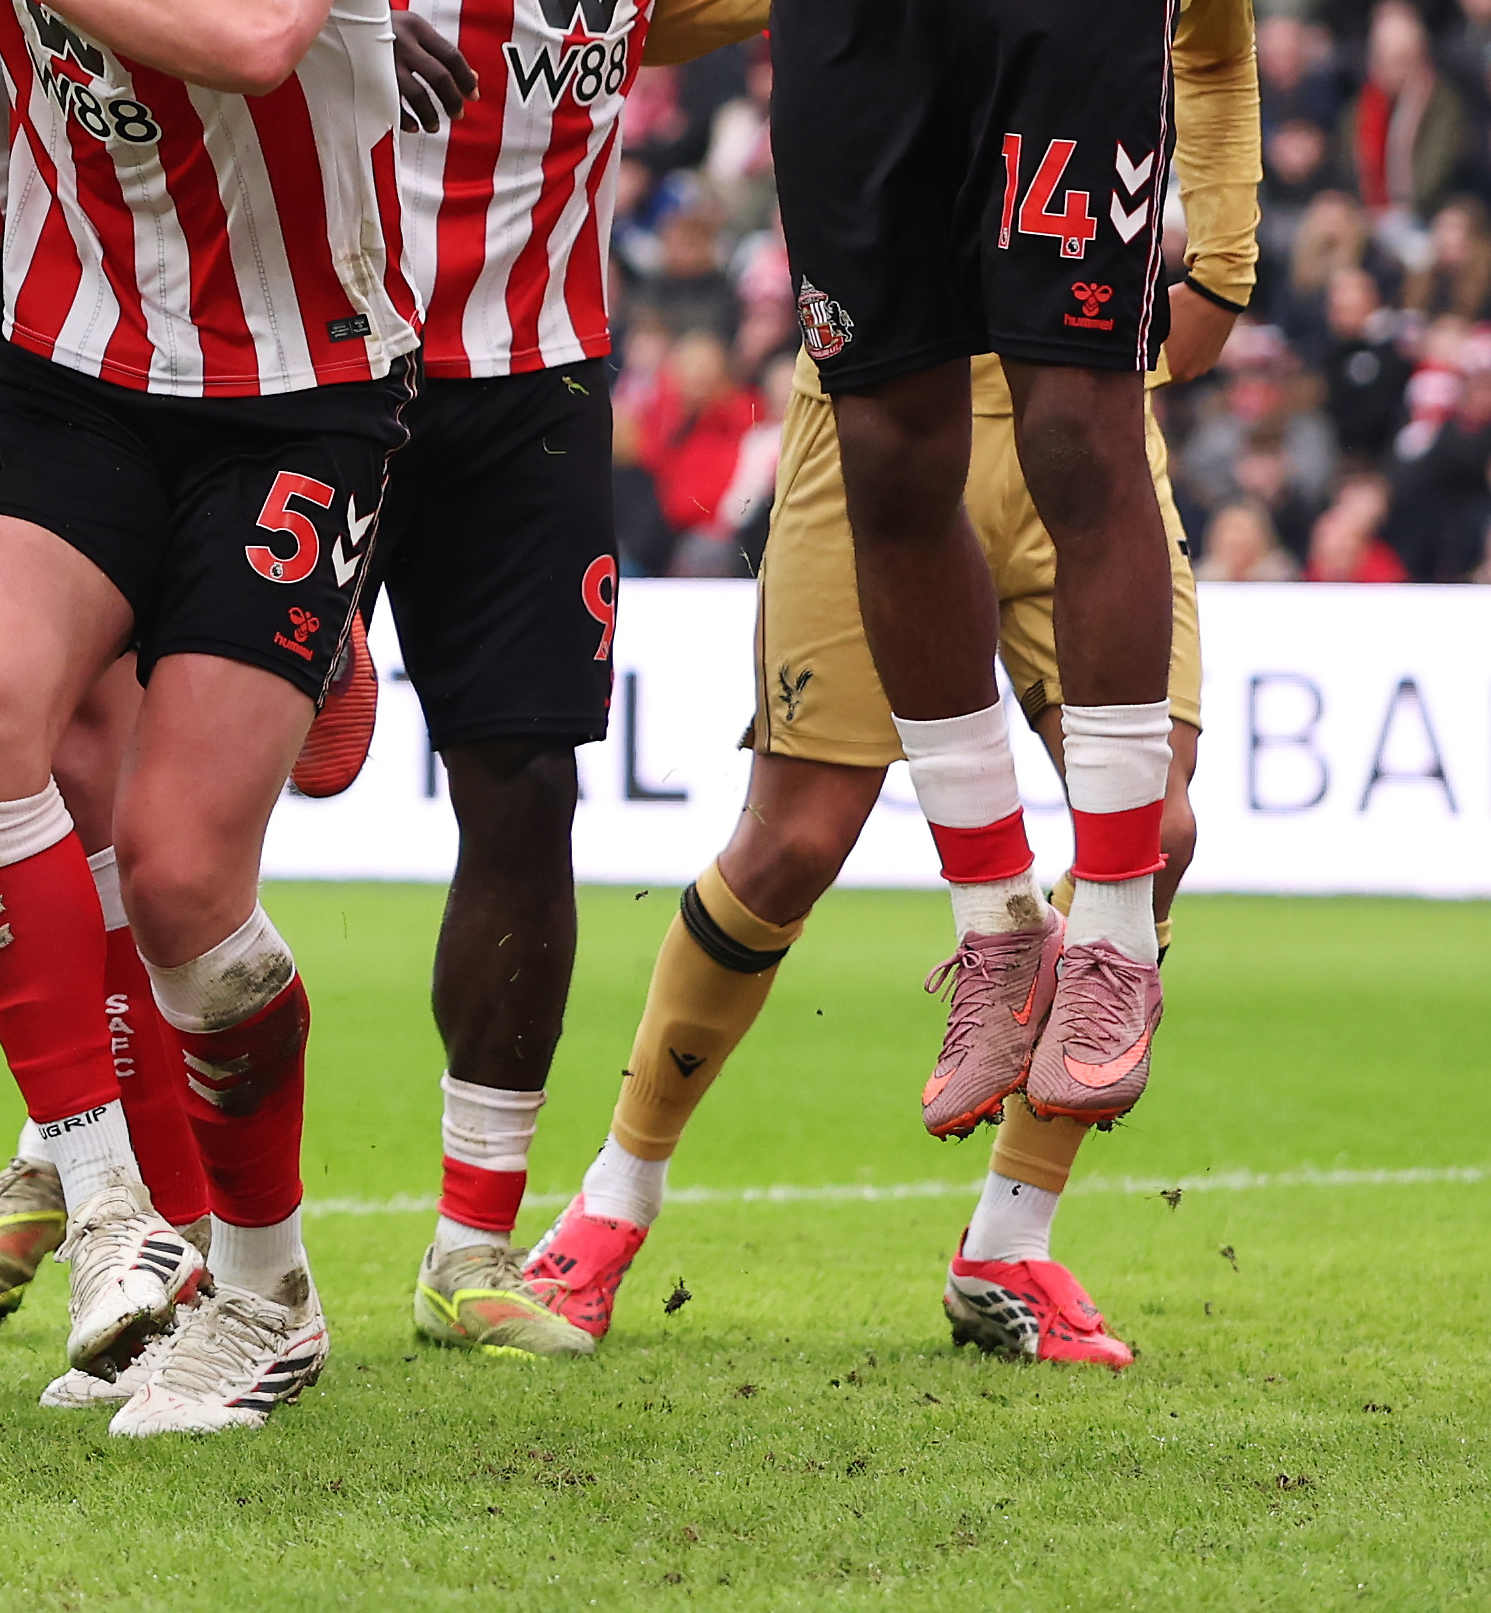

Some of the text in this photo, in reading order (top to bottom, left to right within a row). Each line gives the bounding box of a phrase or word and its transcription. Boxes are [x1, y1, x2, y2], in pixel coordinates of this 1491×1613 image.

[26, 39, 158, 143] W88
[507, 37, 626, 103] W88
[998, 132, 1098, 259] 14
[1064, 313, 1115, 331] hummel
[245, 470, 336, 584] 5
[1246, 672, 1461, 813] BA
[105, 994, 136, 1078] SAFC
